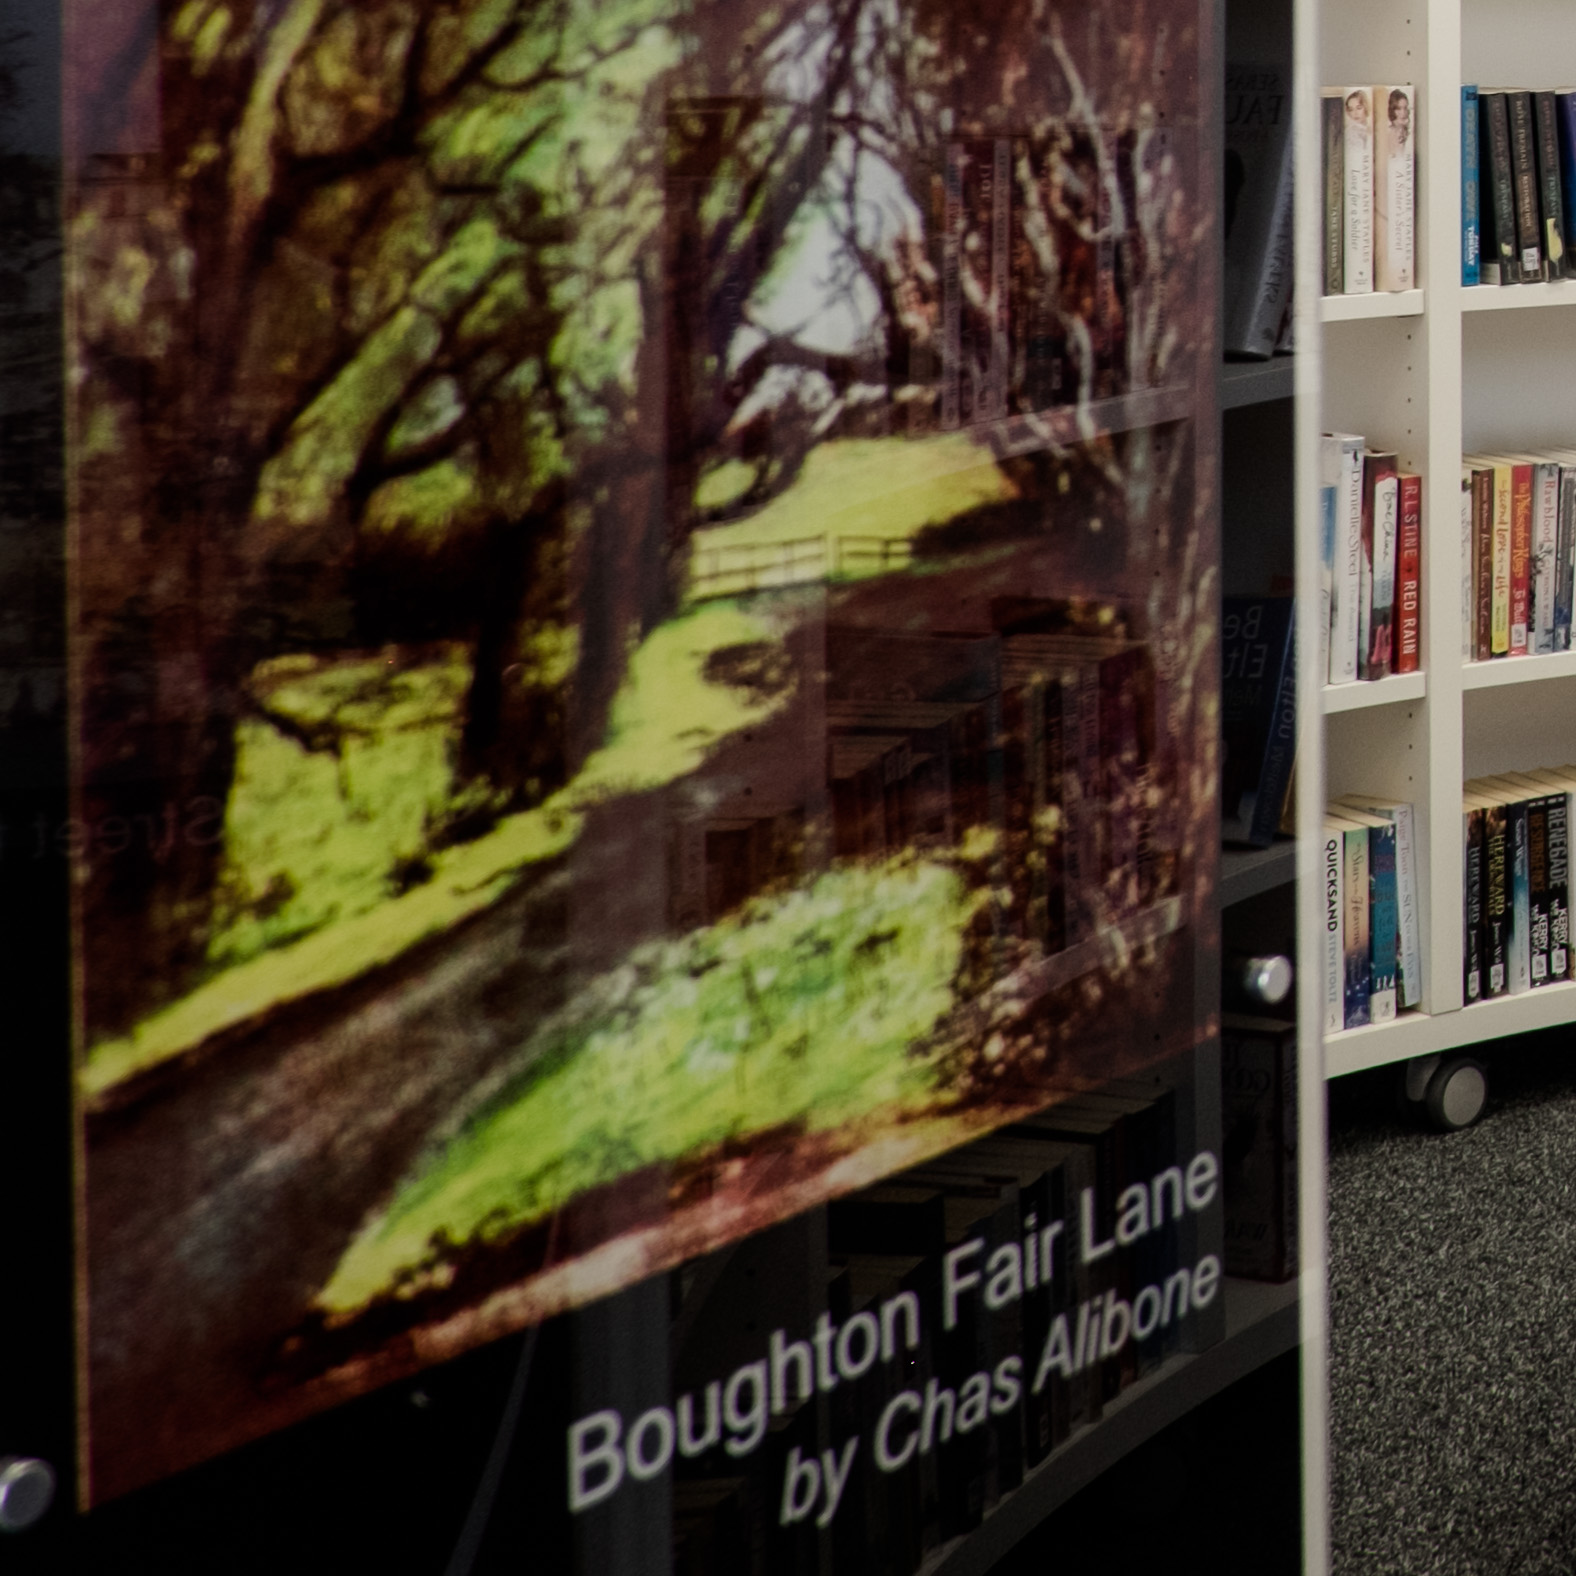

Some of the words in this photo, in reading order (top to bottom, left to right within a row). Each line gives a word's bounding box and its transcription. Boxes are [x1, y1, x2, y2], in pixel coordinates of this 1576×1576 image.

[1351, 169, 1361, 189] Love
[1362, 155, 1370, 184] MARY
[1362, 189, 1370, 212] JANE
[1351, 217, 1360, 250] Soldier
[1362, 218, 1370, 264] STAPLES
[1350, 466, 1361, 533] Danielle
[1542, 480, 1556, 544] Rawblood
[1347, 533, 1359, 575] Steel
[1402, 513, 1417, 558] STINE
[1512, 548, 1530, 579] Kings
[1402, 579, 1417, 609] RED
[1402, 618, 1416, 655] RAIN
[1547, 807, 1568, 889] RENEGADE
[1324, 839, 1338, 932] QUICKSAND
[1468, 846, 1481, 923] HEREWARD
[1493, 834, 1506, 915] HEREWARD
[1537, 913, 1548, 949] KERRY
[1557, 907, 1567, 943] KERRY
[1327, 933, 1337, 967] STEVE
[1327, 969, 1337, 1004] TOLTZ
[567, 1289, 921, 1514] Boughton
[942, 1212, 1065, 1331] Fair
[1079, 1149, 1219, 1264] Lane
[779, 1436, 857, 1529] by
[873, 1355, 1023, 1474] Chas
[1033, 1253, 1222, 1394] Alibone
